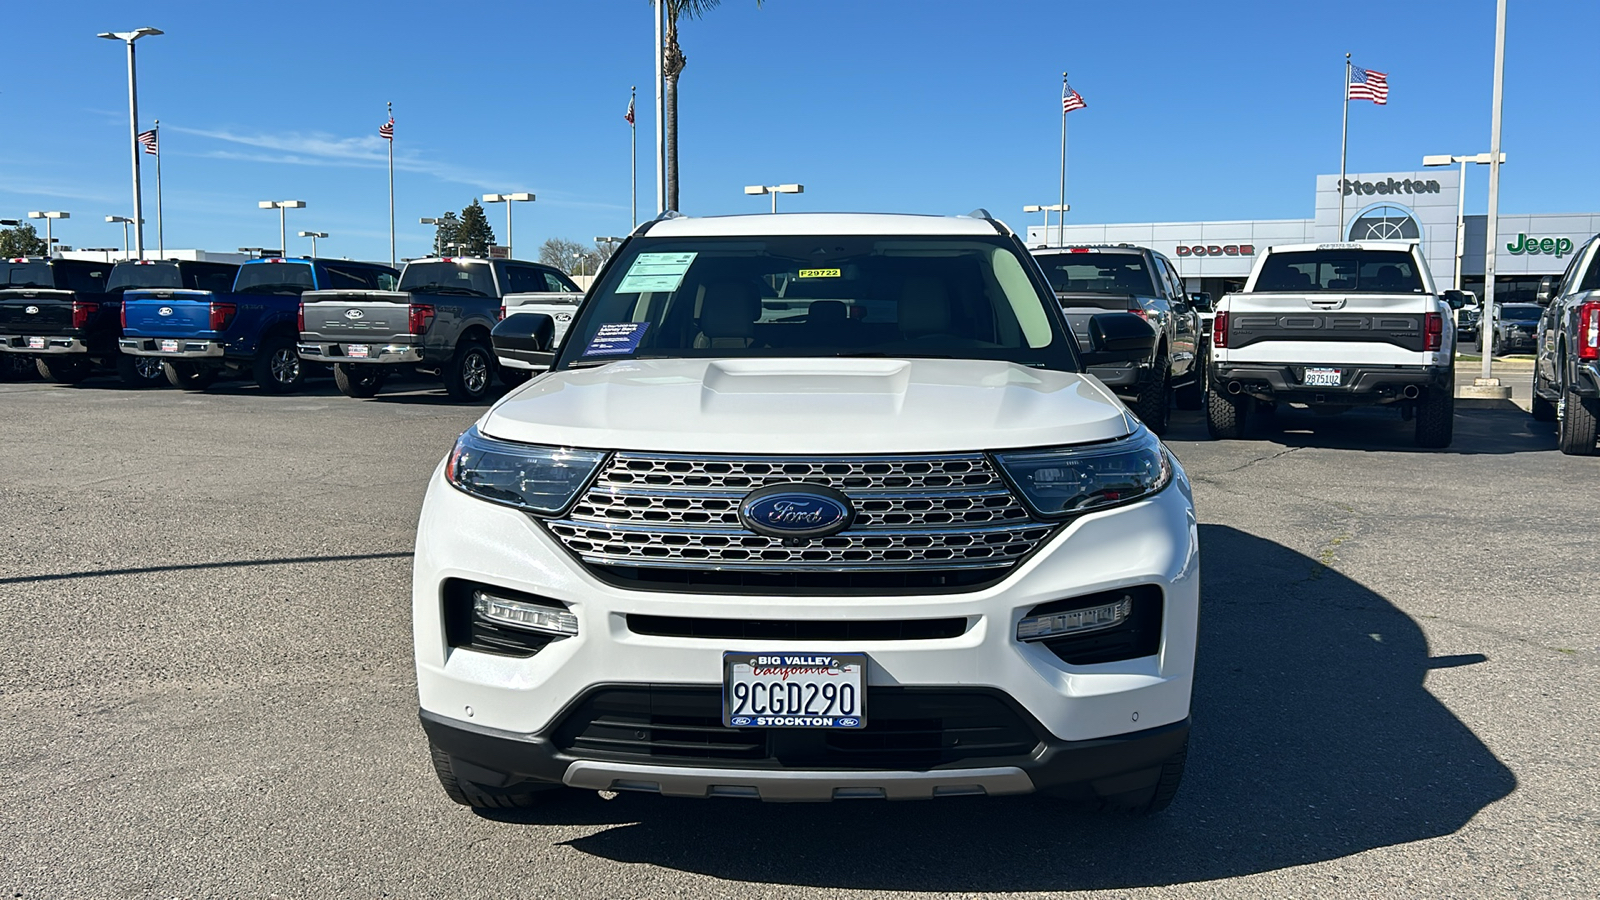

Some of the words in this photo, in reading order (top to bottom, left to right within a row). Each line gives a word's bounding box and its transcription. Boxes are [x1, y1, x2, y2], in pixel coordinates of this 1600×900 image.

[1337, 177, 1440, 196] Stockton
[1176, 245, 1255, 257] DODGE
[1506, 233, 1574, 259] Jeep
[800, 269, 838, 277] F29722
[1233, 316, 1419, 331] FORD
[768, 500, 822, 523] Ford
[758, 656, 781, 665] BIG
[784, 656, 831, 665] VALLEY
[733, 682, 855, 715] 9CGD290
[757, 717, 833, 726] STOCKTON
